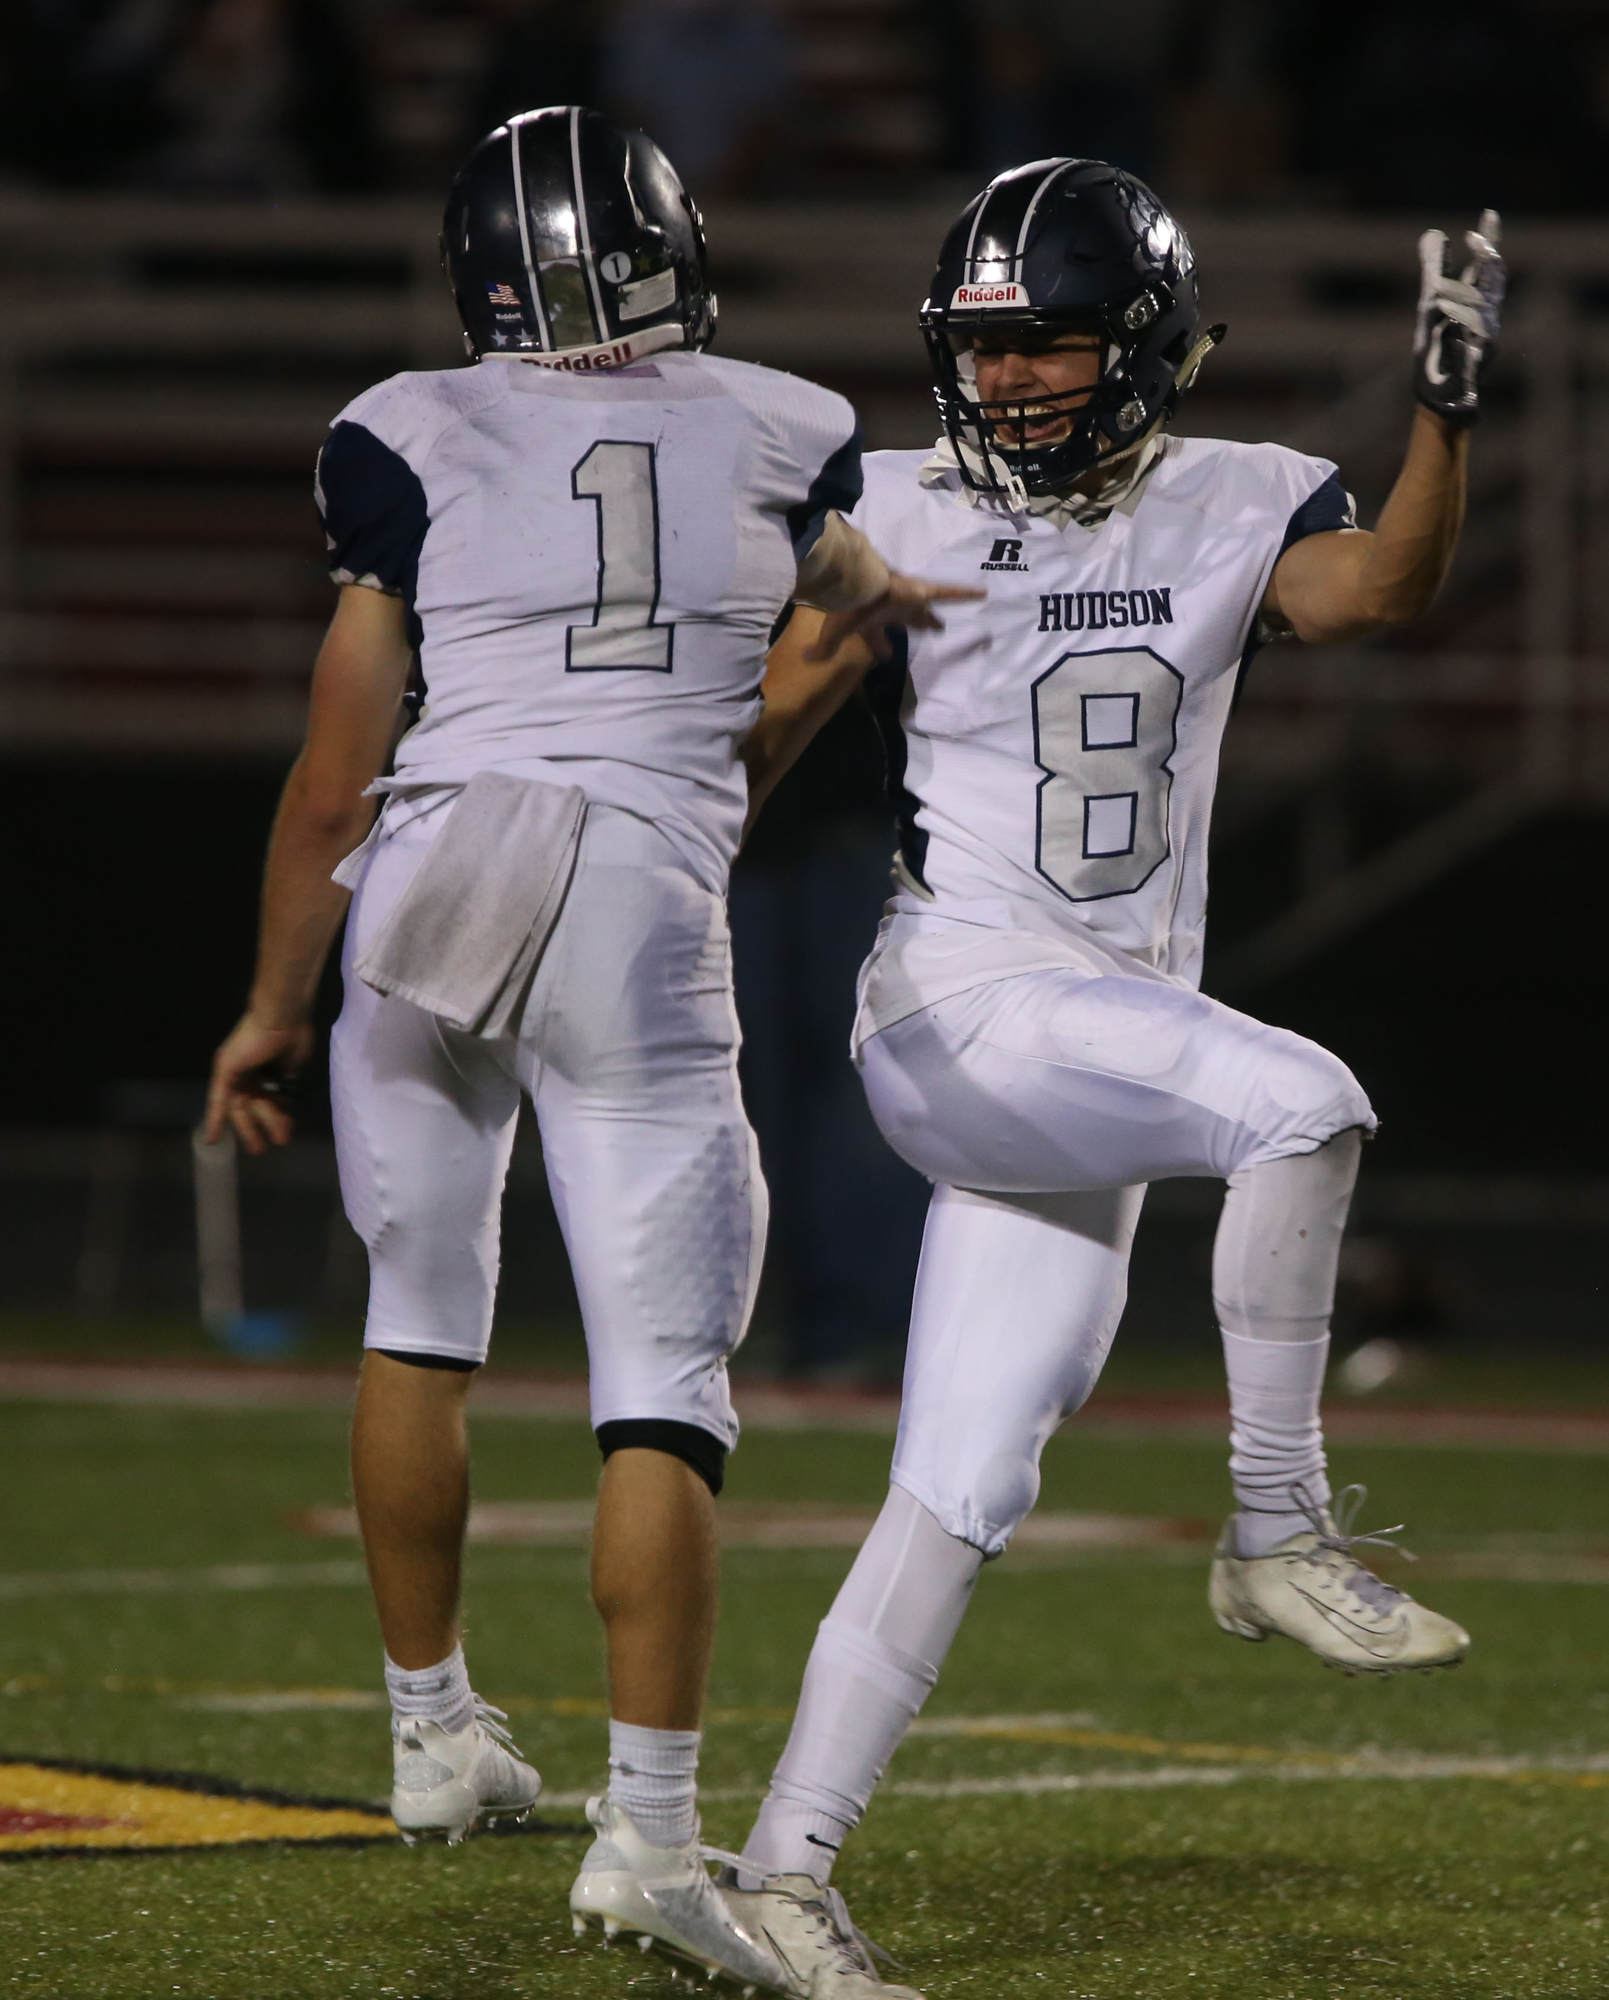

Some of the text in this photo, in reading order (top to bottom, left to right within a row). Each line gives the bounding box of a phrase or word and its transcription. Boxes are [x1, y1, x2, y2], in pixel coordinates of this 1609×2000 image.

[611, 255, 621, 279] 1
[957, 286, 1017, 303] Riddell
[520, 341, 632, 372] ddell
[1010, 463, 1040, 472] Ridell
[565, 439, 675, 673] 1
[989, 539, 1023, 562] R
[980, 562, 1030, 572] RUSSELL
[1038, 587, 1173, 631] HUDSON
[1031, 645, 1185, 903] 8
